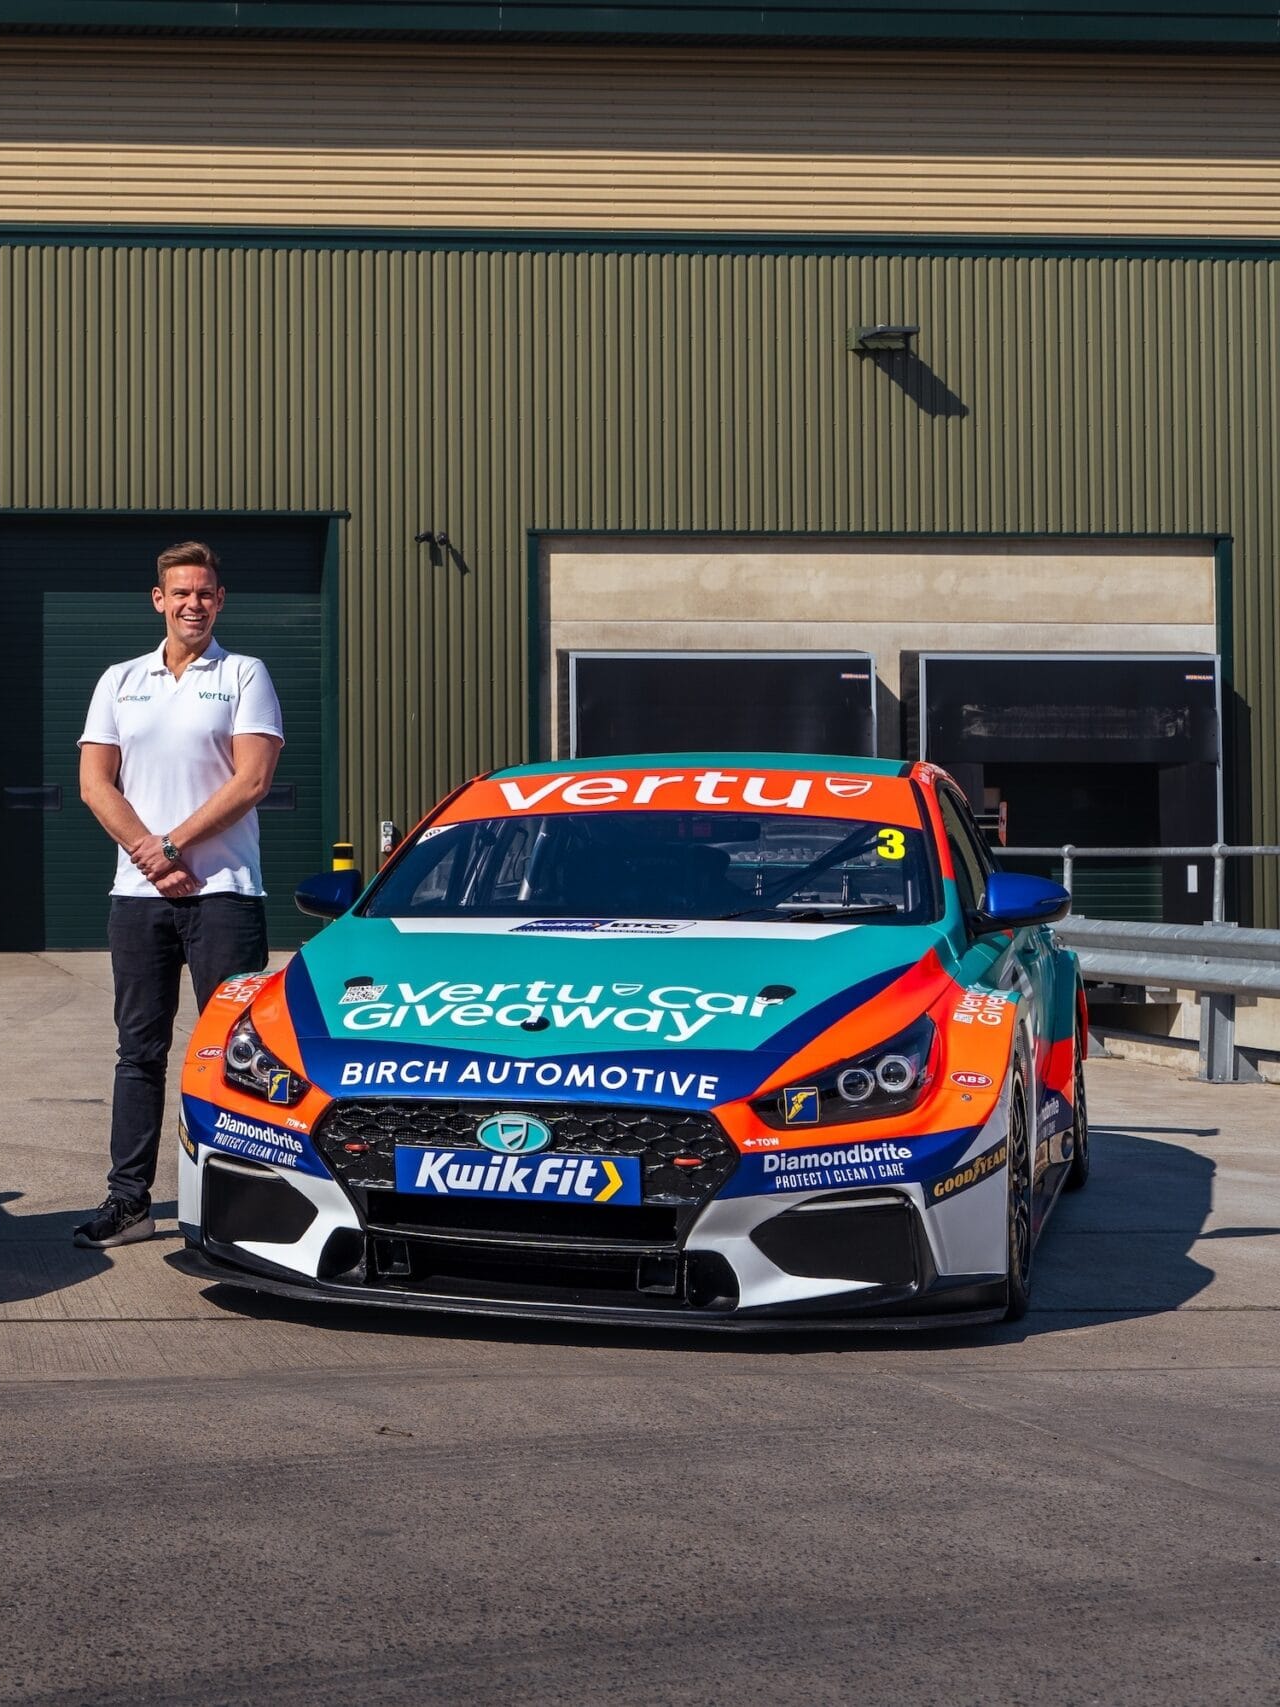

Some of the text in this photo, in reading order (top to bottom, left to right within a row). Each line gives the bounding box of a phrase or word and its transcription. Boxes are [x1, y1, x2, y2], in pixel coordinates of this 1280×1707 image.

[876, 828, 906, 860] 3
[340, 1060, 720, 1101] BIRCH AUTOMOTIVE
[957, 1074, 987, 1085] ABS
[213, 1131, 245, 1150] PROTECT
[247, 1143, 273, 1160] CLEAN
[277, 1151, 298, 1167] CARE
[214, 1112, 304, 1154] Diamondbrite
[756, 1137, 780, 1147] TOW
[763, 1142, 913, 1173] Diamondbrite
[933, 1146, 1007, 1198] GOODYEAR
[775, 1162, 906, 1189] PROTECT CLEAN CARE
